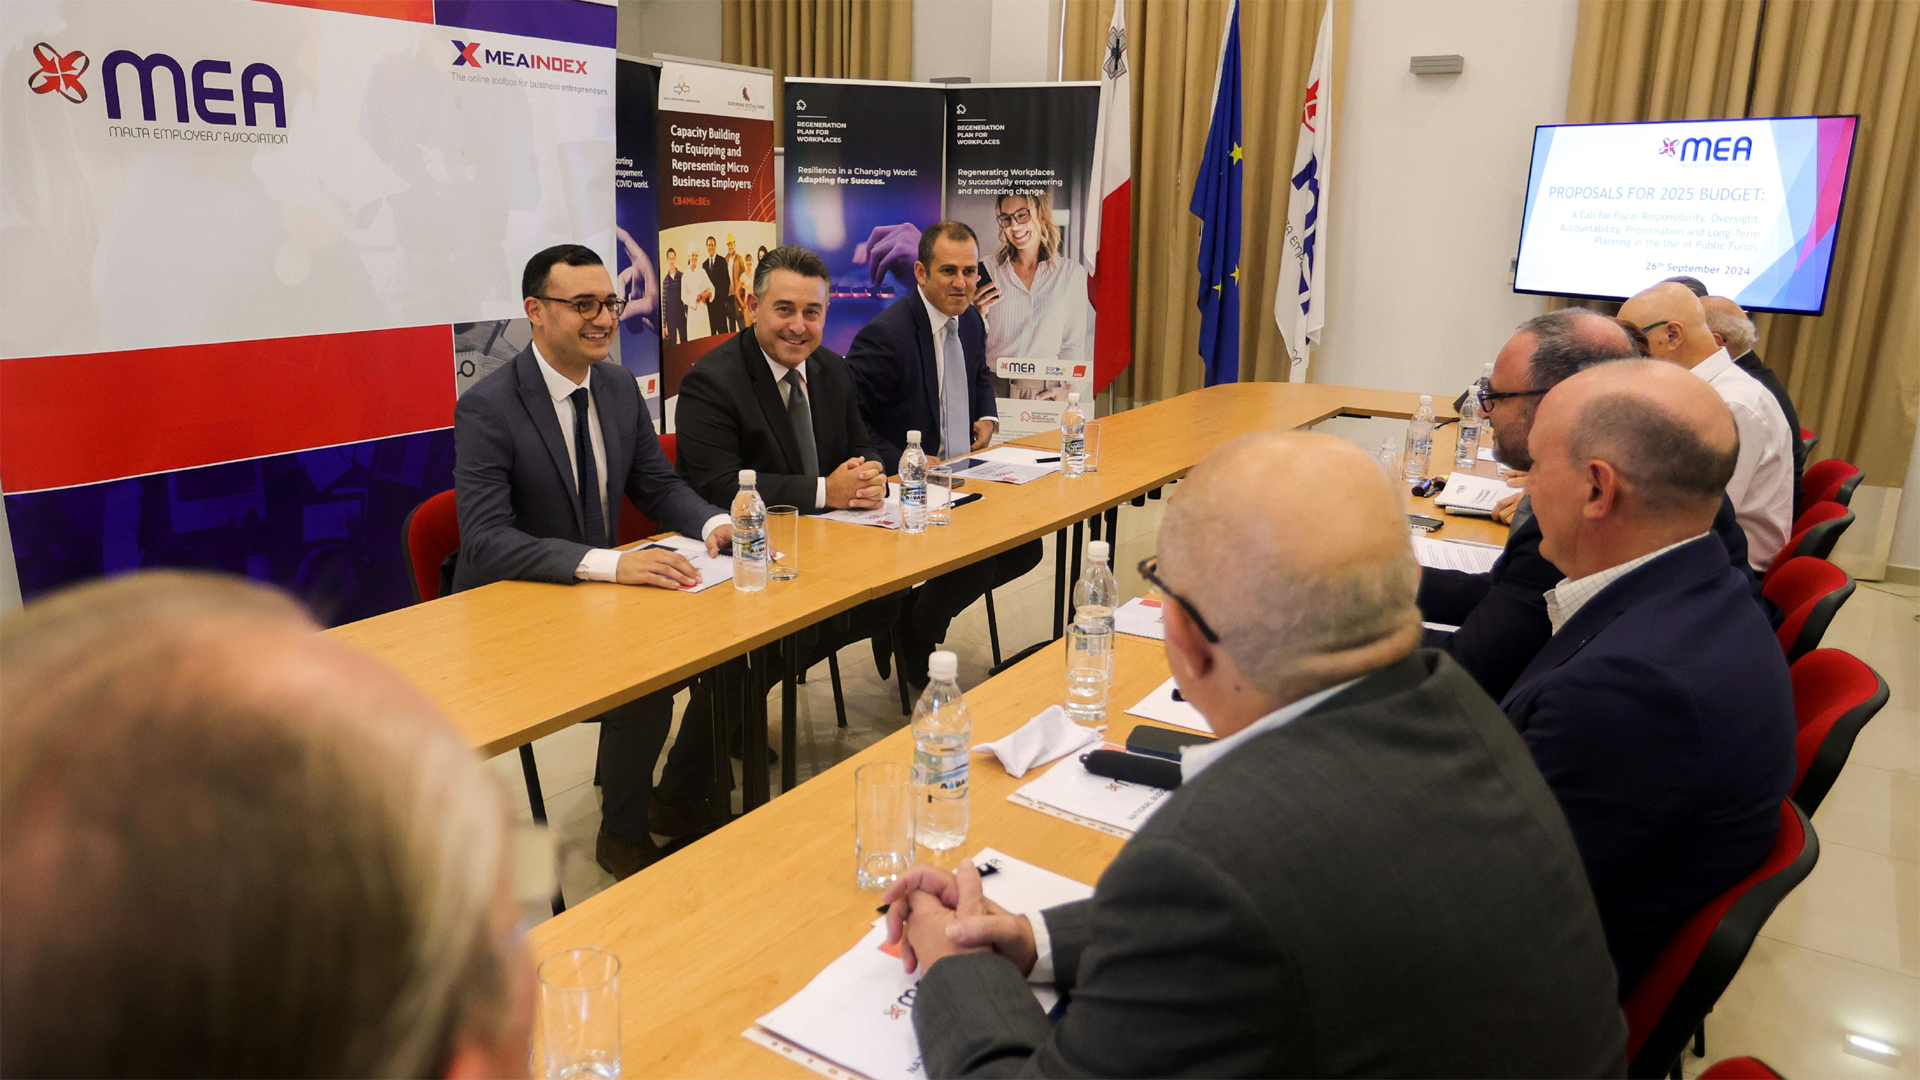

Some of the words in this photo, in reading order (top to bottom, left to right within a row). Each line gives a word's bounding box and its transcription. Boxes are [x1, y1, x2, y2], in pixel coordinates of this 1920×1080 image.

[485, 49, 588, 75] MEAINDEX
[102, 50, 287, 128] MEA
[451, 72, 466, 82] The
[468, 74, 490, 84] online
[491, 76, 517, 87] toolbox
[518, 78, 528, 87] for
[529, 80, 560, 91] business
[561, 84, 608, 96] entrepreneurs
[797, 121, 847, 129] REGENERATION
[109, 126, 150, 139] MALTA
[223, 131, 289, 145] ASSOCIATION
[671, 124, 707, 141] Capacity
[709, 127, 741, 145] Building
[671, 140, 684, 153] for
[685, 143, 726, 160] Equipping
[727, 146, 742, 157] and
[1680, 136, 1752, 161] MEA
[672, 159, 726, 176] Representing
[727, 162, 749, 173] Micro
[798, 166, 837, 175] Resilience
[838, 167, 846, 175] in
[854, 167, 891, 177] Changing
[892, 168, 918, 176] World:
[958, 168, 1009, 177] Regenerating
[1010, 169, 1055, 177] Workplaces
[633, 180, 649, 188] world.
[672, 175, 710, 188] Business
[711, 177, 752, 191] Employers
[797, 176, 835, 185] Adapting
[836, 176, 849, 184] for
[850, 177, 885, 185] Success.
[958, 178, 967, 186] by
[968, 178, 1013, 187] successfully
[1014, 178, 1063, 187] empowering
[973, 188, 1014, 196] embracing
[1015, 188, 1046, 196] change.
[1549, 186, 1623, 200] PROPOSALS
[1627, 187, 1656, 200] FOR
[1660, 187, 1695, 201] 2025
[1699, 188, 1765, 202] BUDGET:
[672, 196, 711, 206] CB4MicBEs
[1572, 211, 1578, 219] A
[1579, 210, 1596, 219] Call
[1599, 210, 1611, 220] for
[1613, 211, 1639, 220] Fiscal
[1641, 211, 1707, 224] Responsibility,
[1560, 223, 1622, 235] Accountability,
[1625, 225, 1685, 236] Prioritisation
[1687, 227, 1705, 237] and
[1594, 236, 1631, 248] Planning
[1634, 238, 1642, 246] in
[1645, 238, 1660, 247] the
[1663, 239, 1680, 248] Use
[1682, 240, 1693, 248] of
[1695, 240, 1725, 251] Public
[1728, 241, 1758, 252] Funds
[1646, 261, 1665, 271] 26th
[1667, 262, 1721, 275] September
[1724, 266, 1751, 276] 2024
[1009, 362, 1035, 373] MEA
